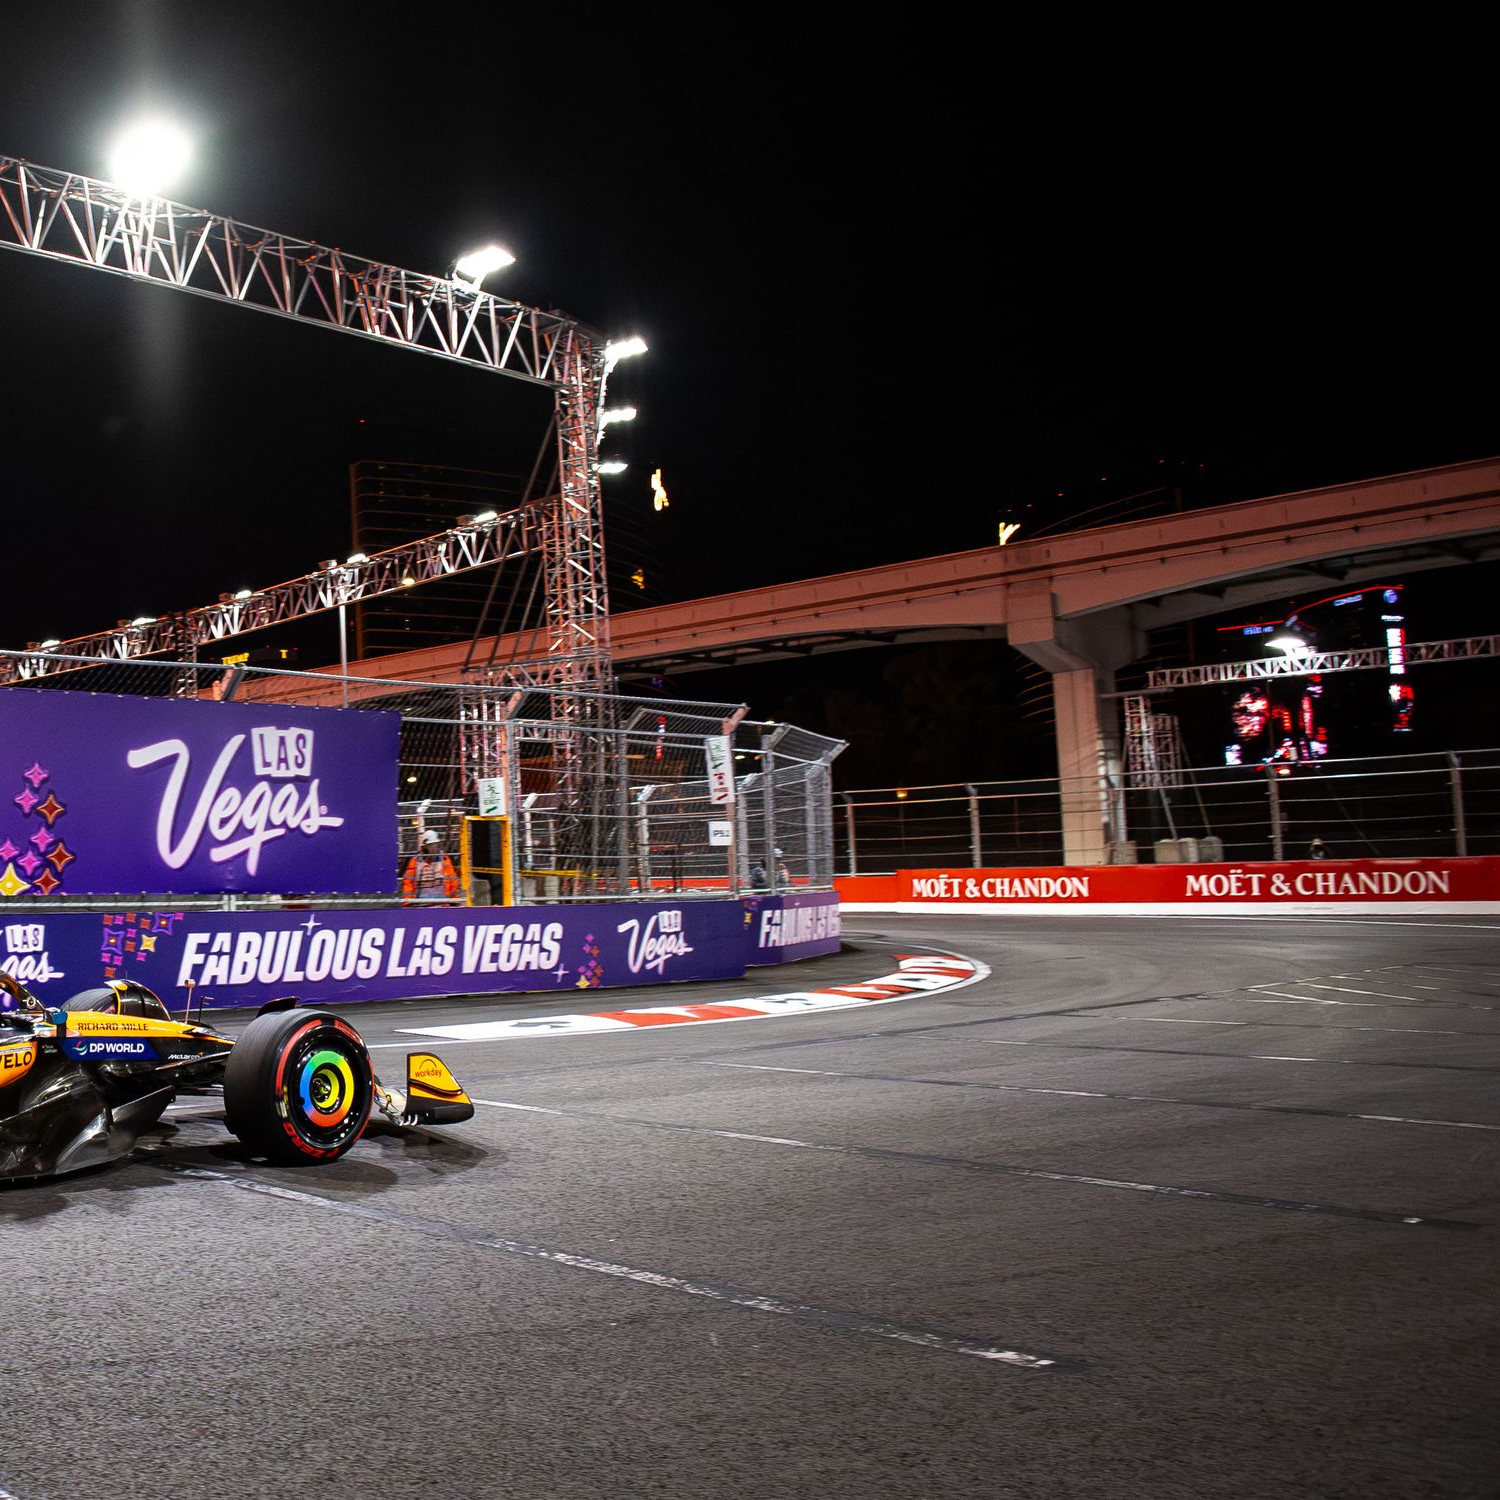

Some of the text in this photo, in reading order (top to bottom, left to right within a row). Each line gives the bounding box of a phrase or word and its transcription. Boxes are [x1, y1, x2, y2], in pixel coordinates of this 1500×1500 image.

[257, 731, 308, 772] LAS
[127, 734, 344, 876] Vegas
[965, 878, 981, 898] &
[981, 876, 1089, 898] CHANDON
[1185, 869, 1450, 897] MOËT & CHANDON
[8, 926, 42, 950] LAS
[617, 915, 694, 975] Vegas
[176, 923, 564, 987] FABULOUS LAS VEGAS
[77, 1022, 149, 1032] RICHARD MILLE
[89, 1043, 145, 1053] DP WORLD
[414, 1068, 442, 1078] workday
